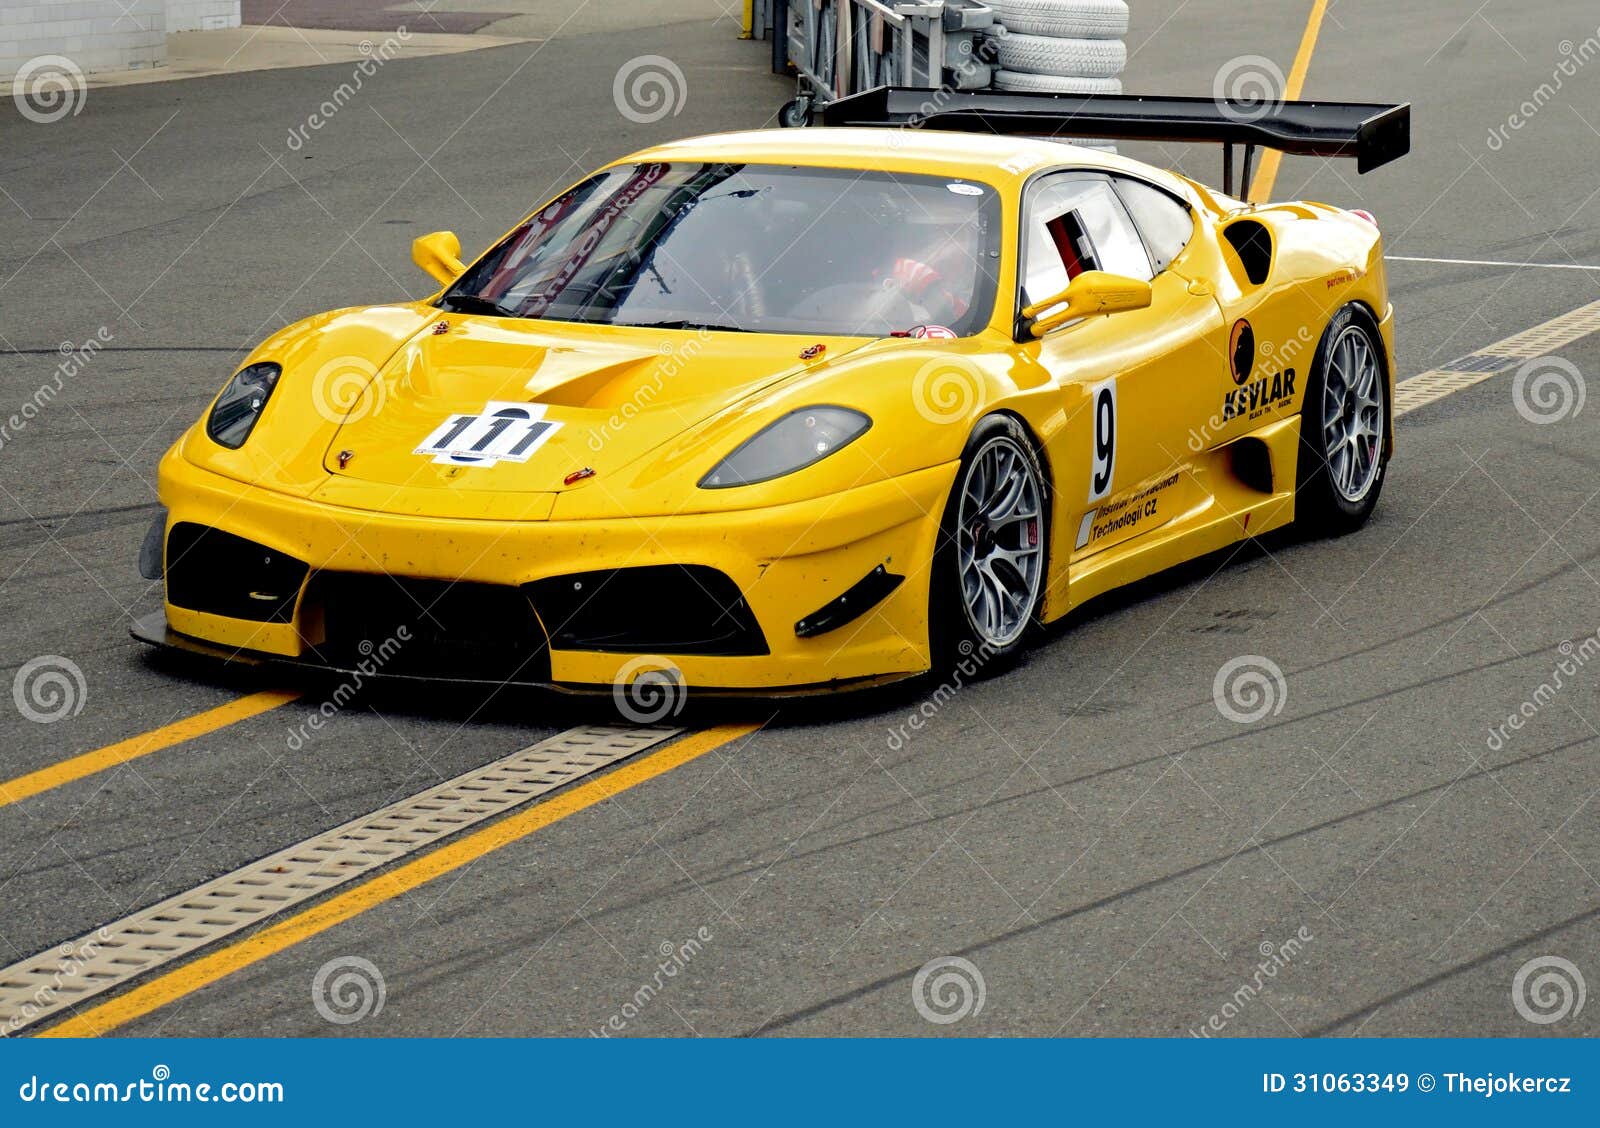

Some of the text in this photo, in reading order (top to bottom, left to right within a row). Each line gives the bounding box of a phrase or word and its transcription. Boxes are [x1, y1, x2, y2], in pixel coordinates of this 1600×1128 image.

[1223, 368, 1295, 421] KEVLAR
[1094, 388, 1114, 495] 9
[1144, 498, 1158, 517] CZ
